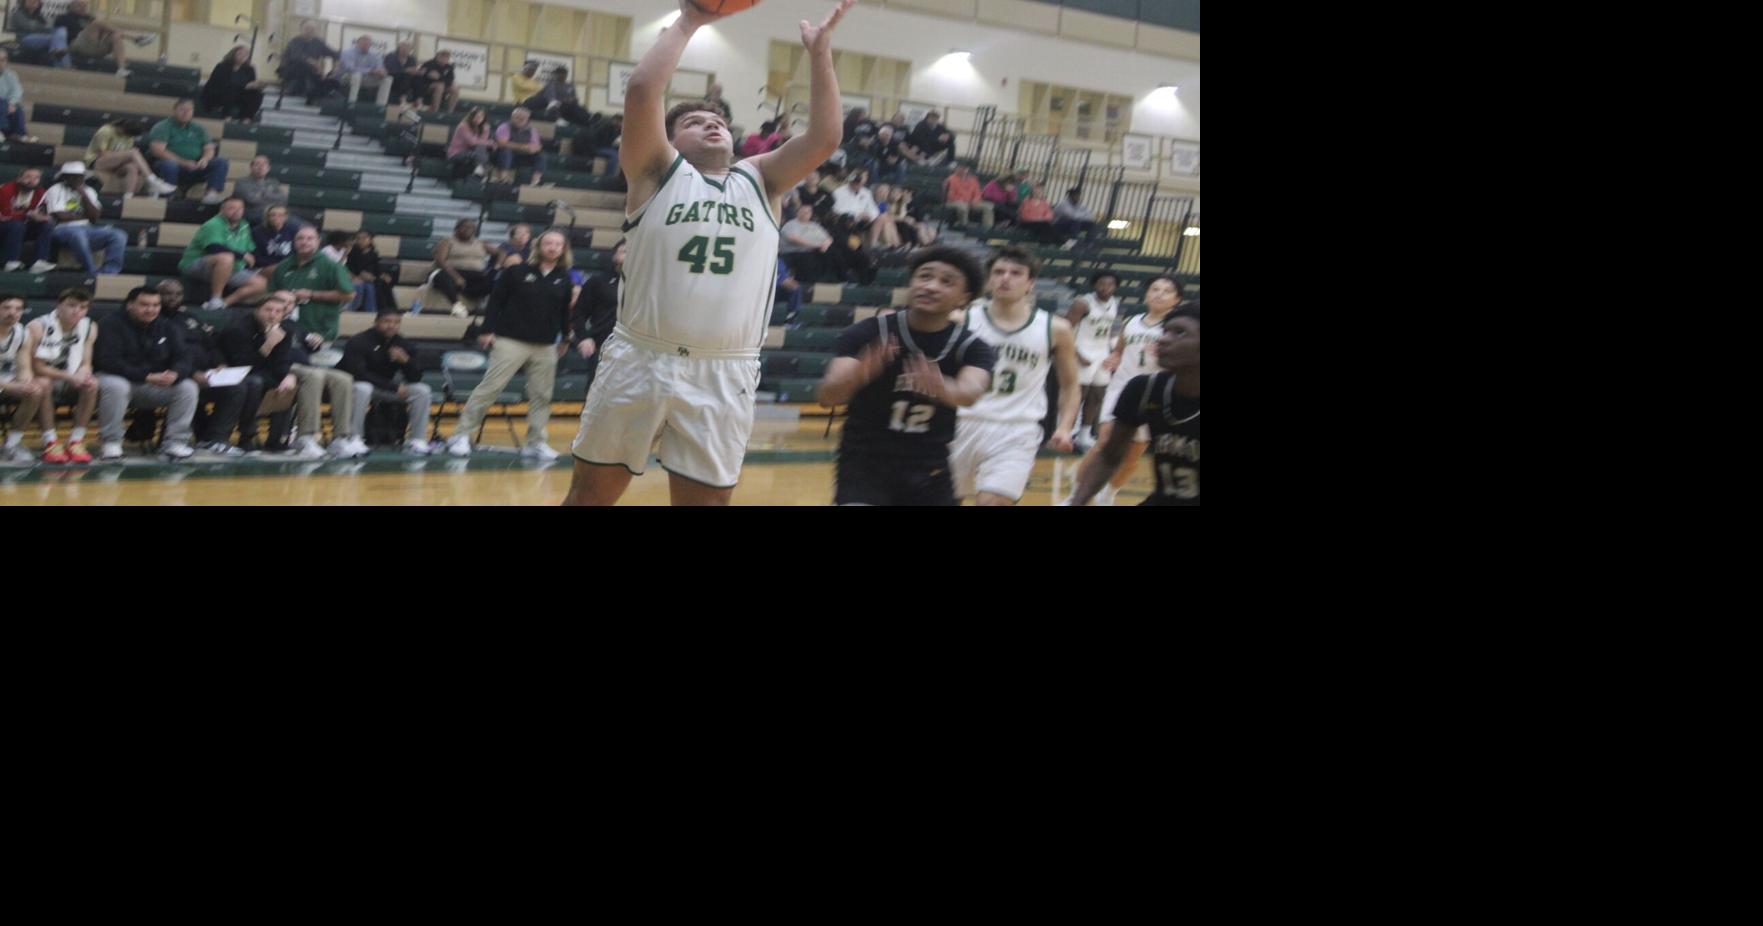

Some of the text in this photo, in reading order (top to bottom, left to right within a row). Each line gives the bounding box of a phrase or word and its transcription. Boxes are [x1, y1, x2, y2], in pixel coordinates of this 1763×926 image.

[677, 235, 735, 275] 45
[990, 368, 1016, 395] 3
[887, 400, 936, 433] 12
[1157, 462, 1199, 499] 13
